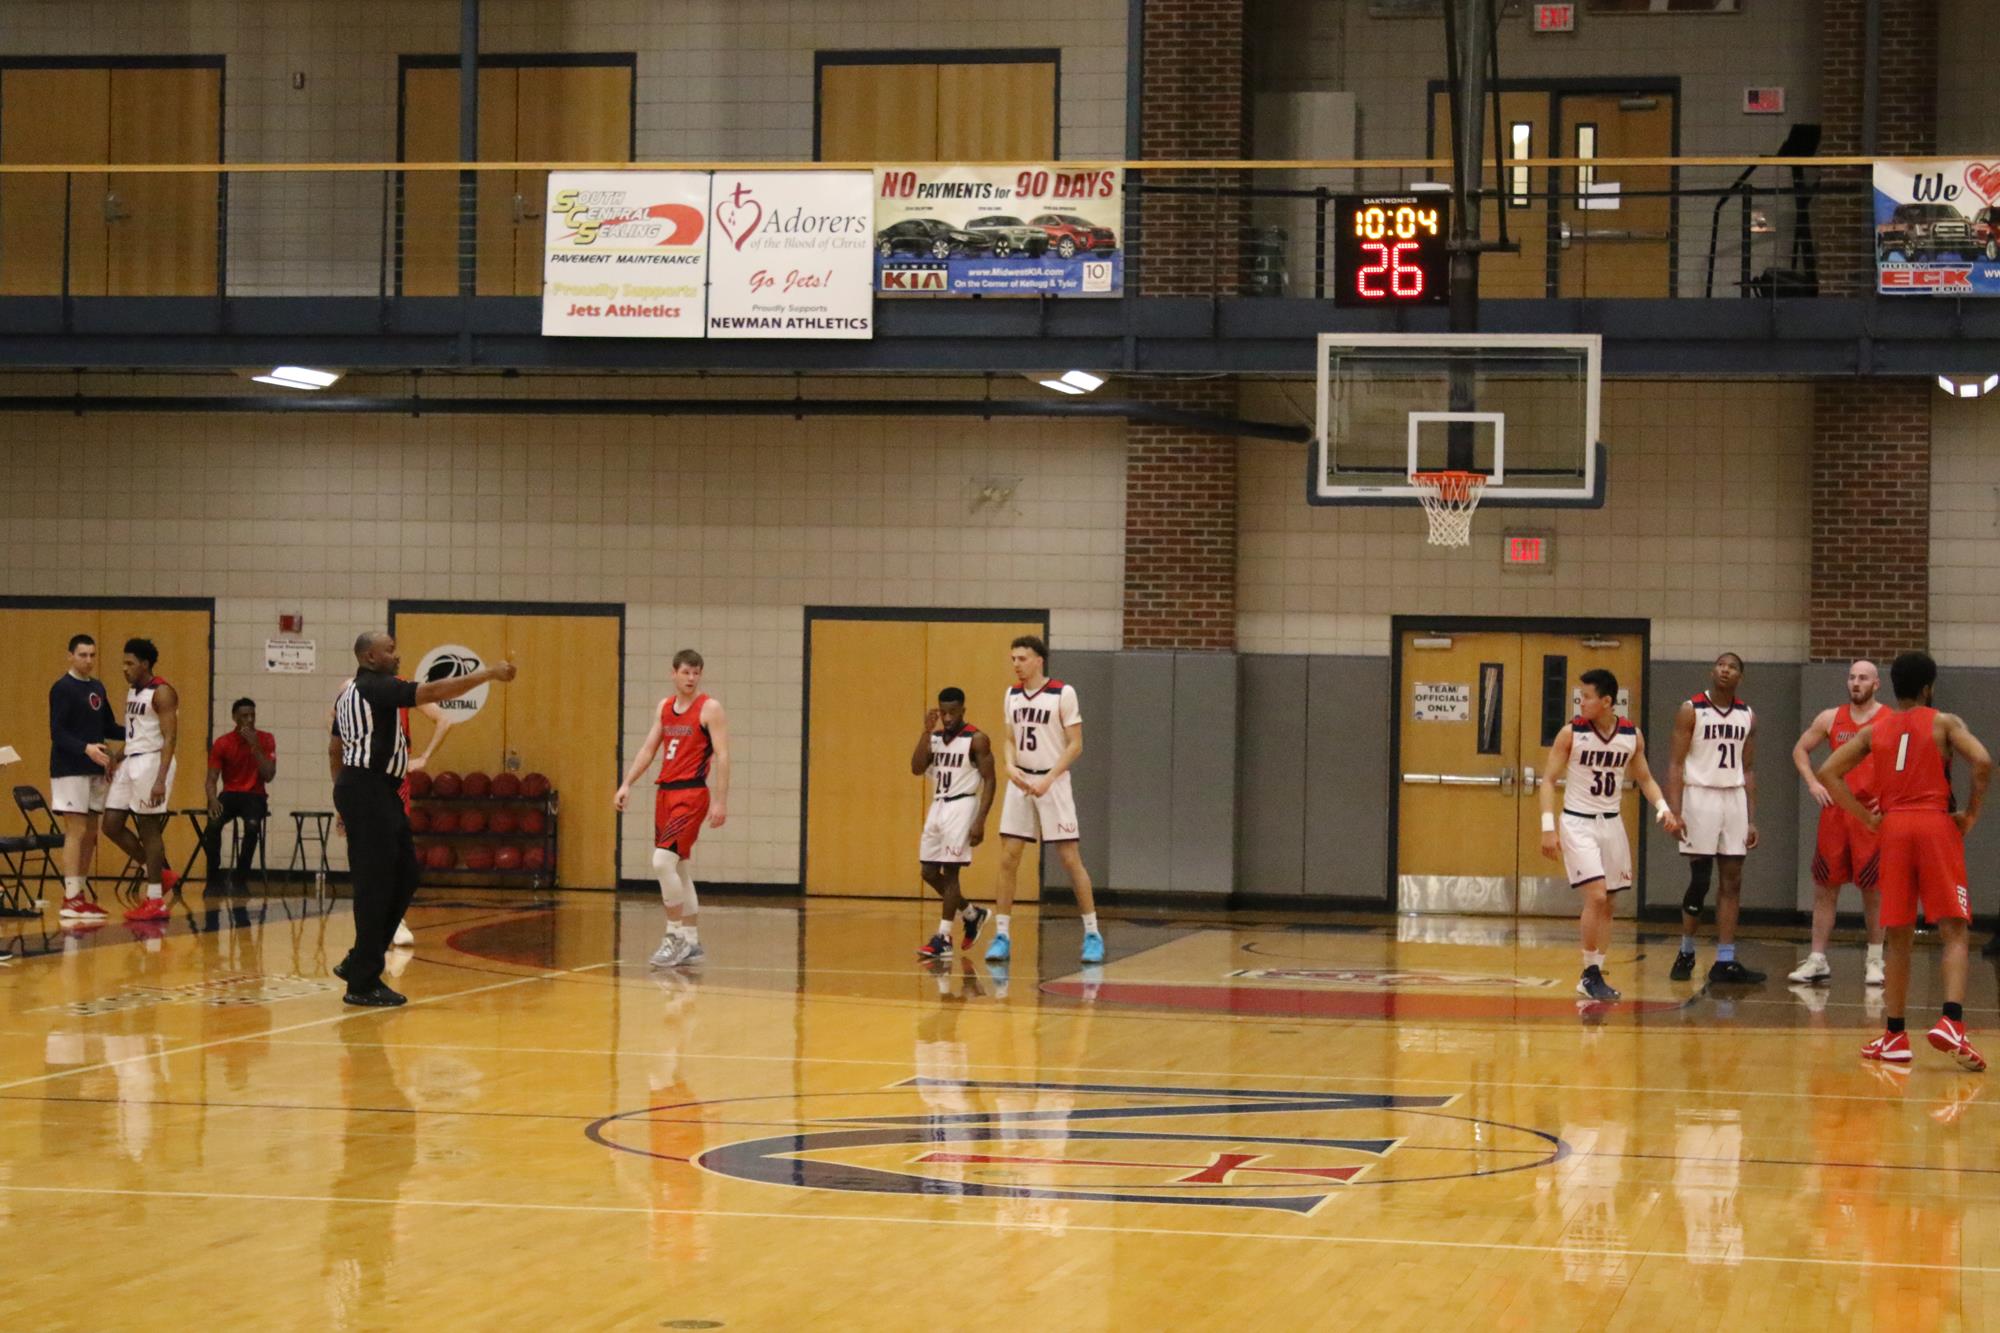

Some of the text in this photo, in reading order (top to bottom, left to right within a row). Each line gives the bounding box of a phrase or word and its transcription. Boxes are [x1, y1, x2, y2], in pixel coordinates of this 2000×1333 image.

[1541, 6, 1569, 30] EXIT
[881, 171, 1116, 199] NO PAYMENTS for 90 DAYS
[1912, 173, 1964, 202] We
[1363, 197, 1418, 205] DAKTRONICS
[565, 206, 651, 229] CENTRAL
[762, 207, 867, 233] Adorers
[1355, 207, 1438, 240] 10:04
[550, 254, 700, 265] PAVEMENT MAINTENANCE
[1358, 242, 1423, 297] 26
[749, 269, 833, 294] Go Jets!
[884, 272, 944, 289] KIA
[1087, 264, 1105, 279] 10
[1882, 271, 1971, 286] ECK
[567, 304, 680, 318] Jets Athletics
[752, 304, 828, 314] Proudly Supports
[711, 317, 868, 330] NEWMAN ATHLETICS
[1511, 538, 1541, 561] EXIT
[438, 699, 478, 710] ASKETBALL
[1415, 694, 1469, 702] OFFICIALS
[1427, 704, 1456, 712] ONLY
[666, 739, 680, 760] 5
[1019, 727, 1038, 751] 15
[1718, 743, 1736, 769] 21
[1896, 732, 1910, 772] 1
[1590, 770, 1616, 797] 30
